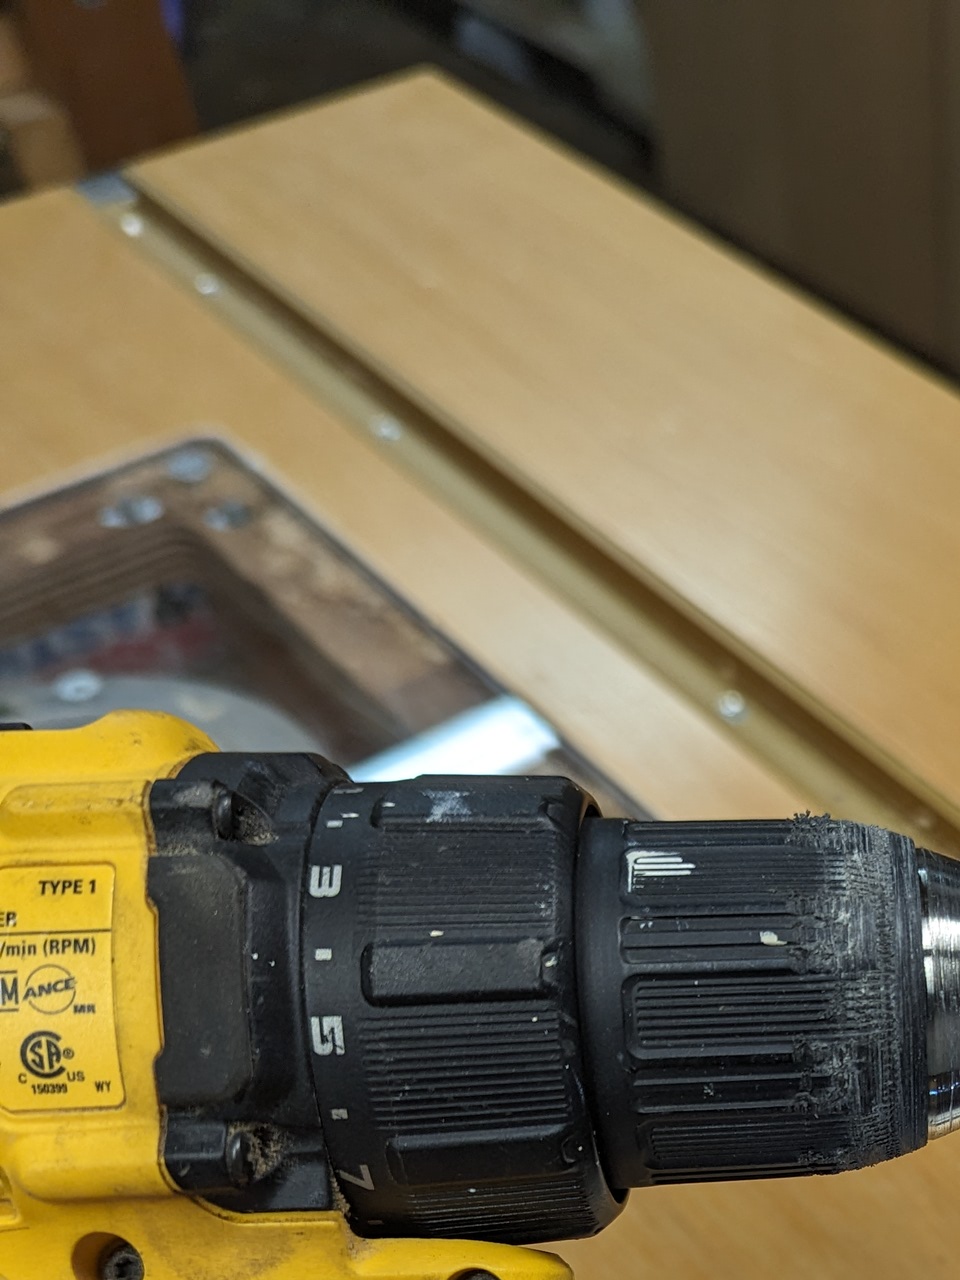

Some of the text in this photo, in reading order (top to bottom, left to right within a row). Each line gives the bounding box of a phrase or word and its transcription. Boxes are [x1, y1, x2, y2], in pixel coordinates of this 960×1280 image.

[38, 879, 97, 895] TYPE 1
[308, 864, 342, 898] 3
[0, 938, 96, 958] /min (RPM)
[23, 976, 76, 1001] ANCE
[310, 1016, 345, 1055] 5
[66, 1071, 85, 1083] US
[94, 1081, 111, 1093] WY
[339, 1164, 374, 1191] 7
